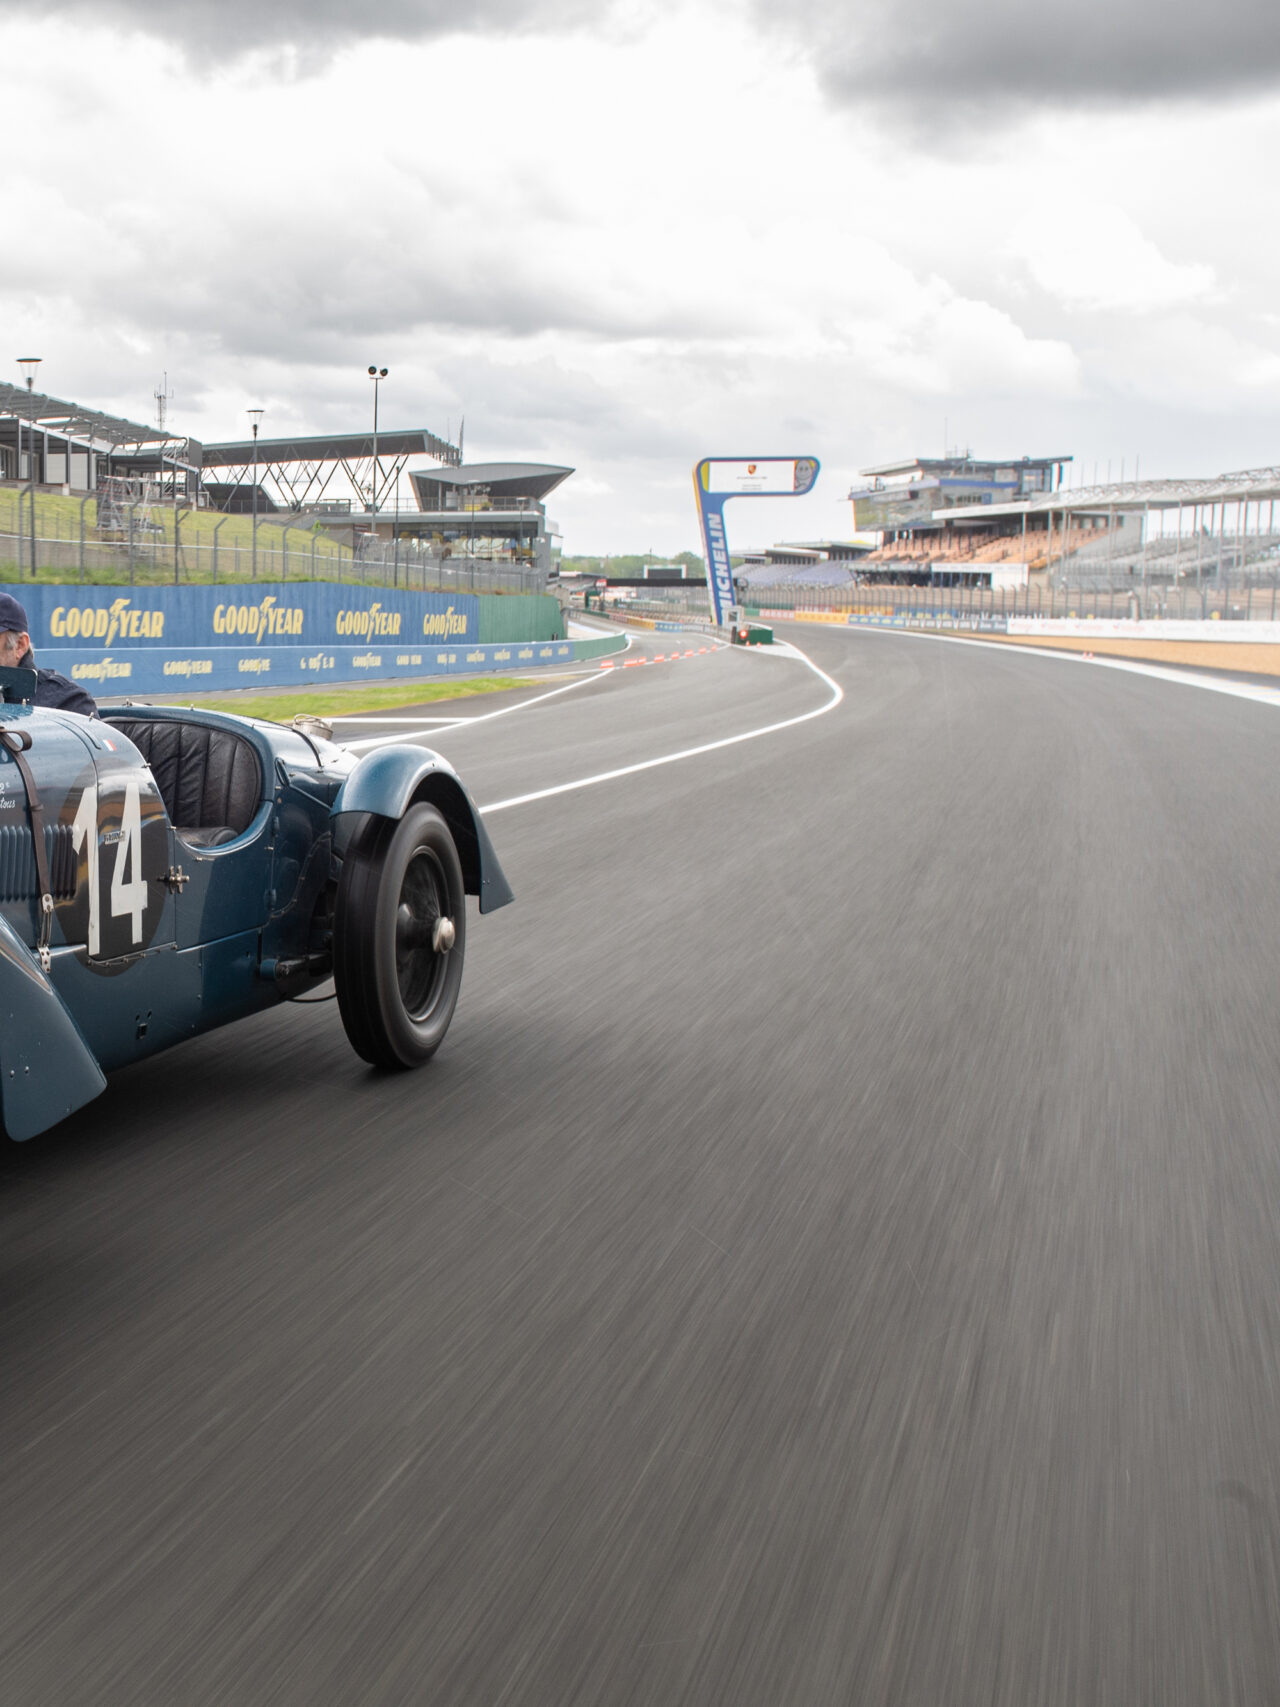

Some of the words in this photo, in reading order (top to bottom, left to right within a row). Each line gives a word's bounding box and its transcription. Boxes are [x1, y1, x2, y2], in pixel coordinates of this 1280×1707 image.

[50, 606, 165, 638] GOODYEAR
[213, 604, 304, 635] GOODYEAR
[336, 610, 401, 635] GOODYEAR
[423, 613, 467, 635] GOODYEAR
[72, 782, 148, 955] 14
